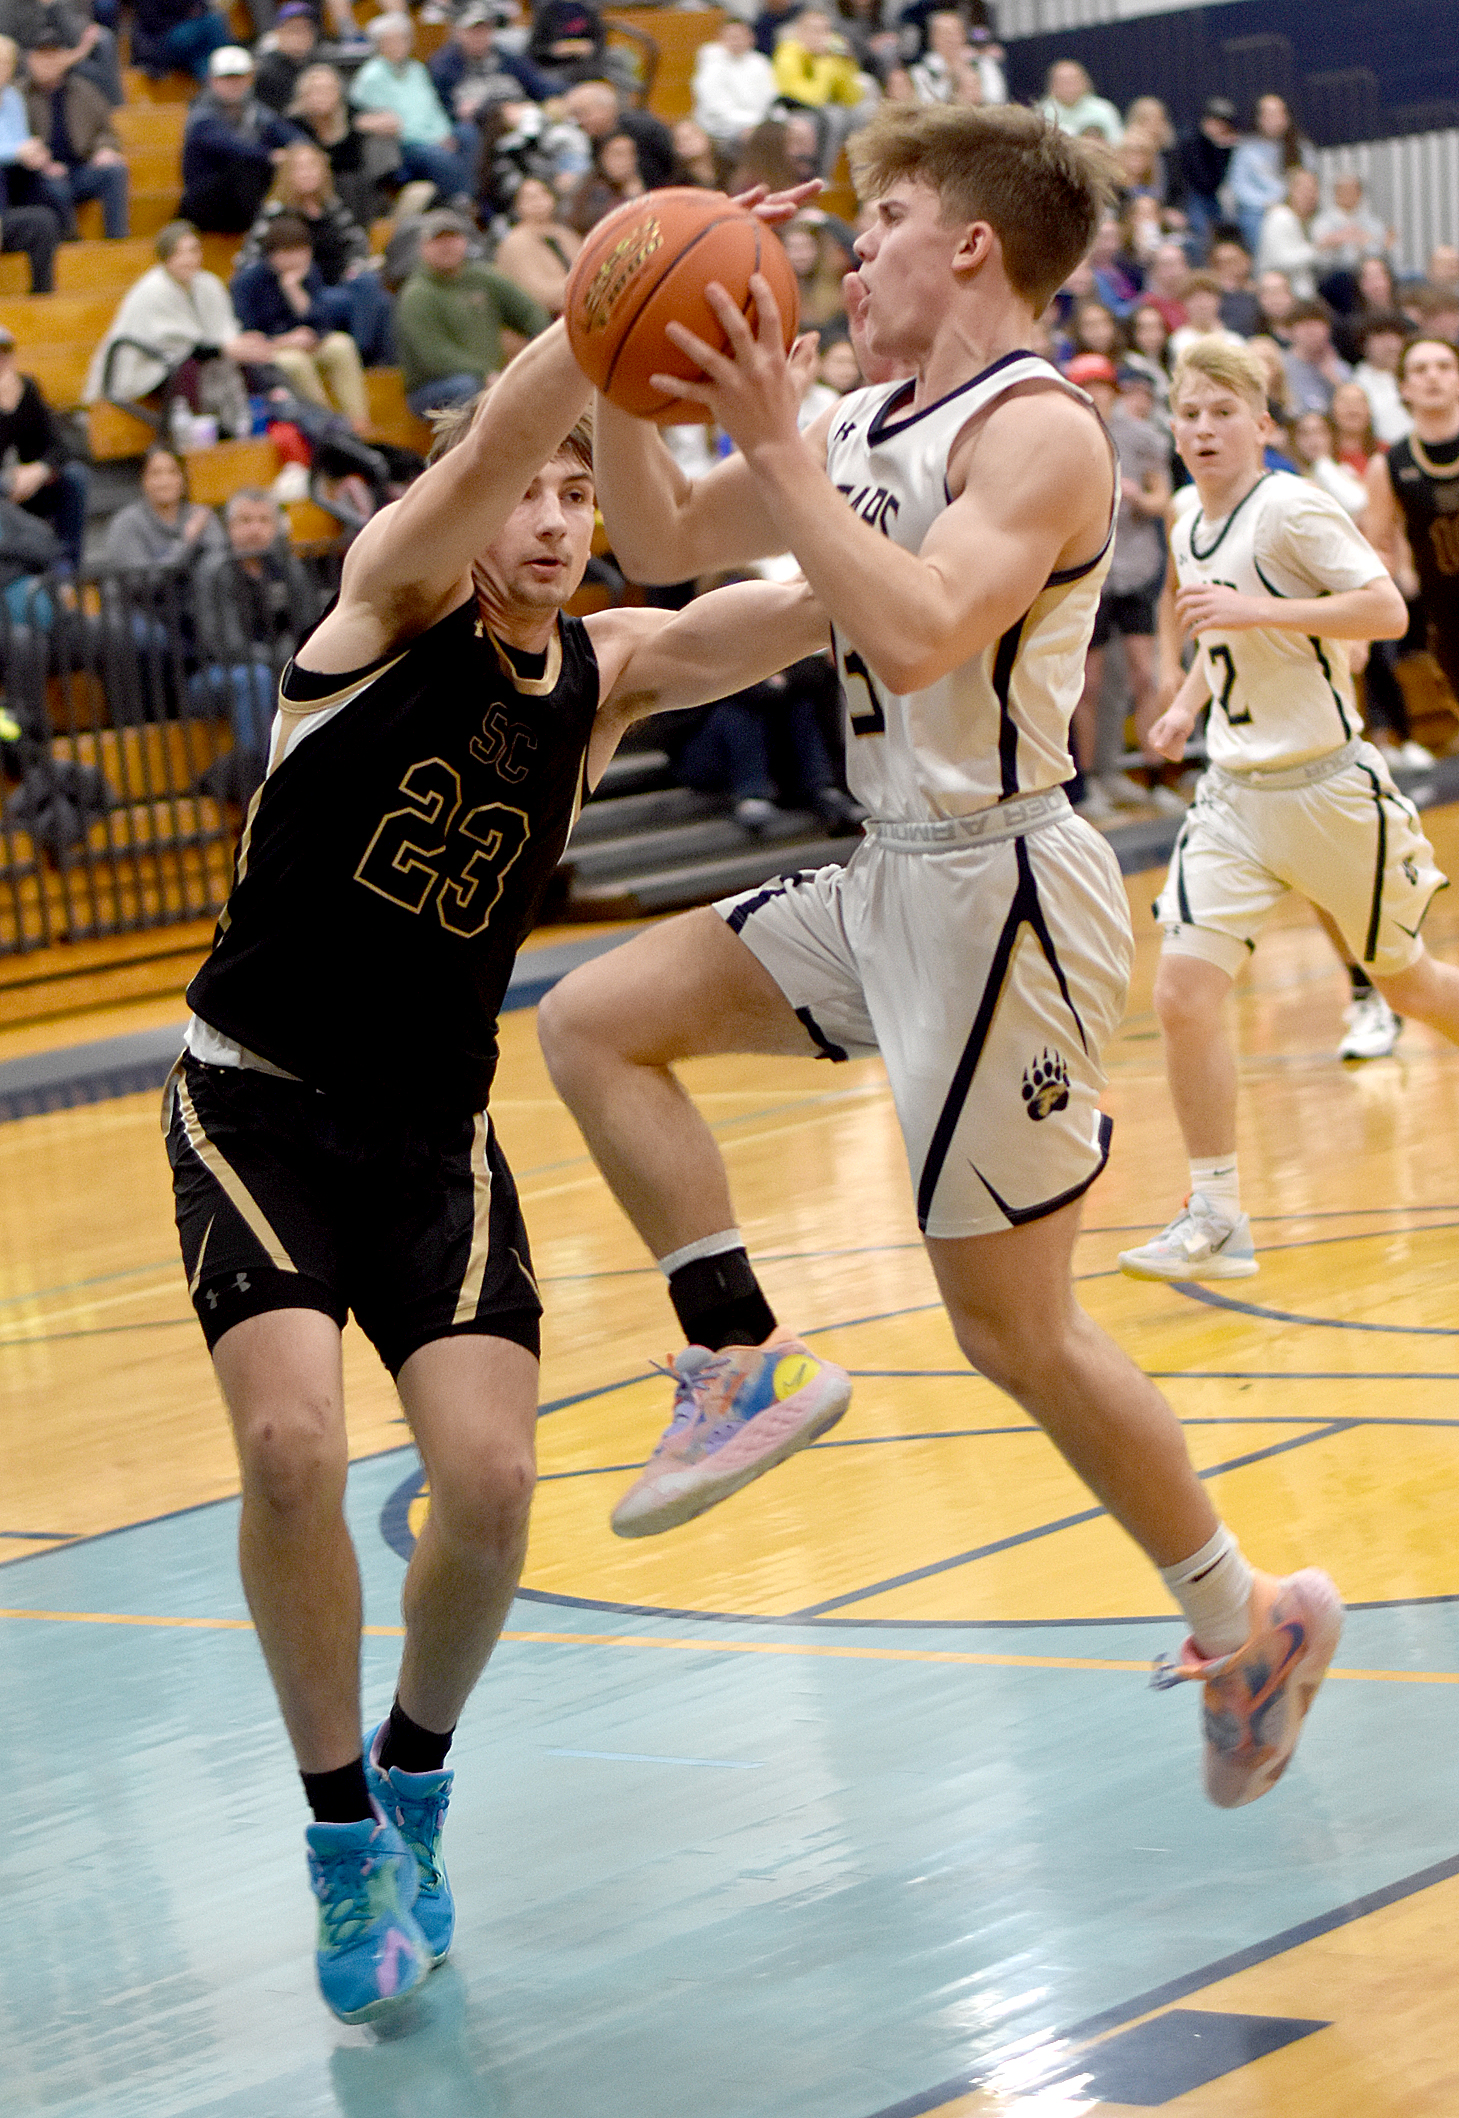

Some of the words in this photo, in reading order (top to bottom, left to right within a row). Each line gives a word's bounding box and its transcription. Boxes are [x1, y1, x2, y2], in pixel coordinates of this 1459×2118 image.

[1209, 644, 1252, 726] 2
[470, 701, 538, 783] SC
[353, 757, 530, 938] 23
